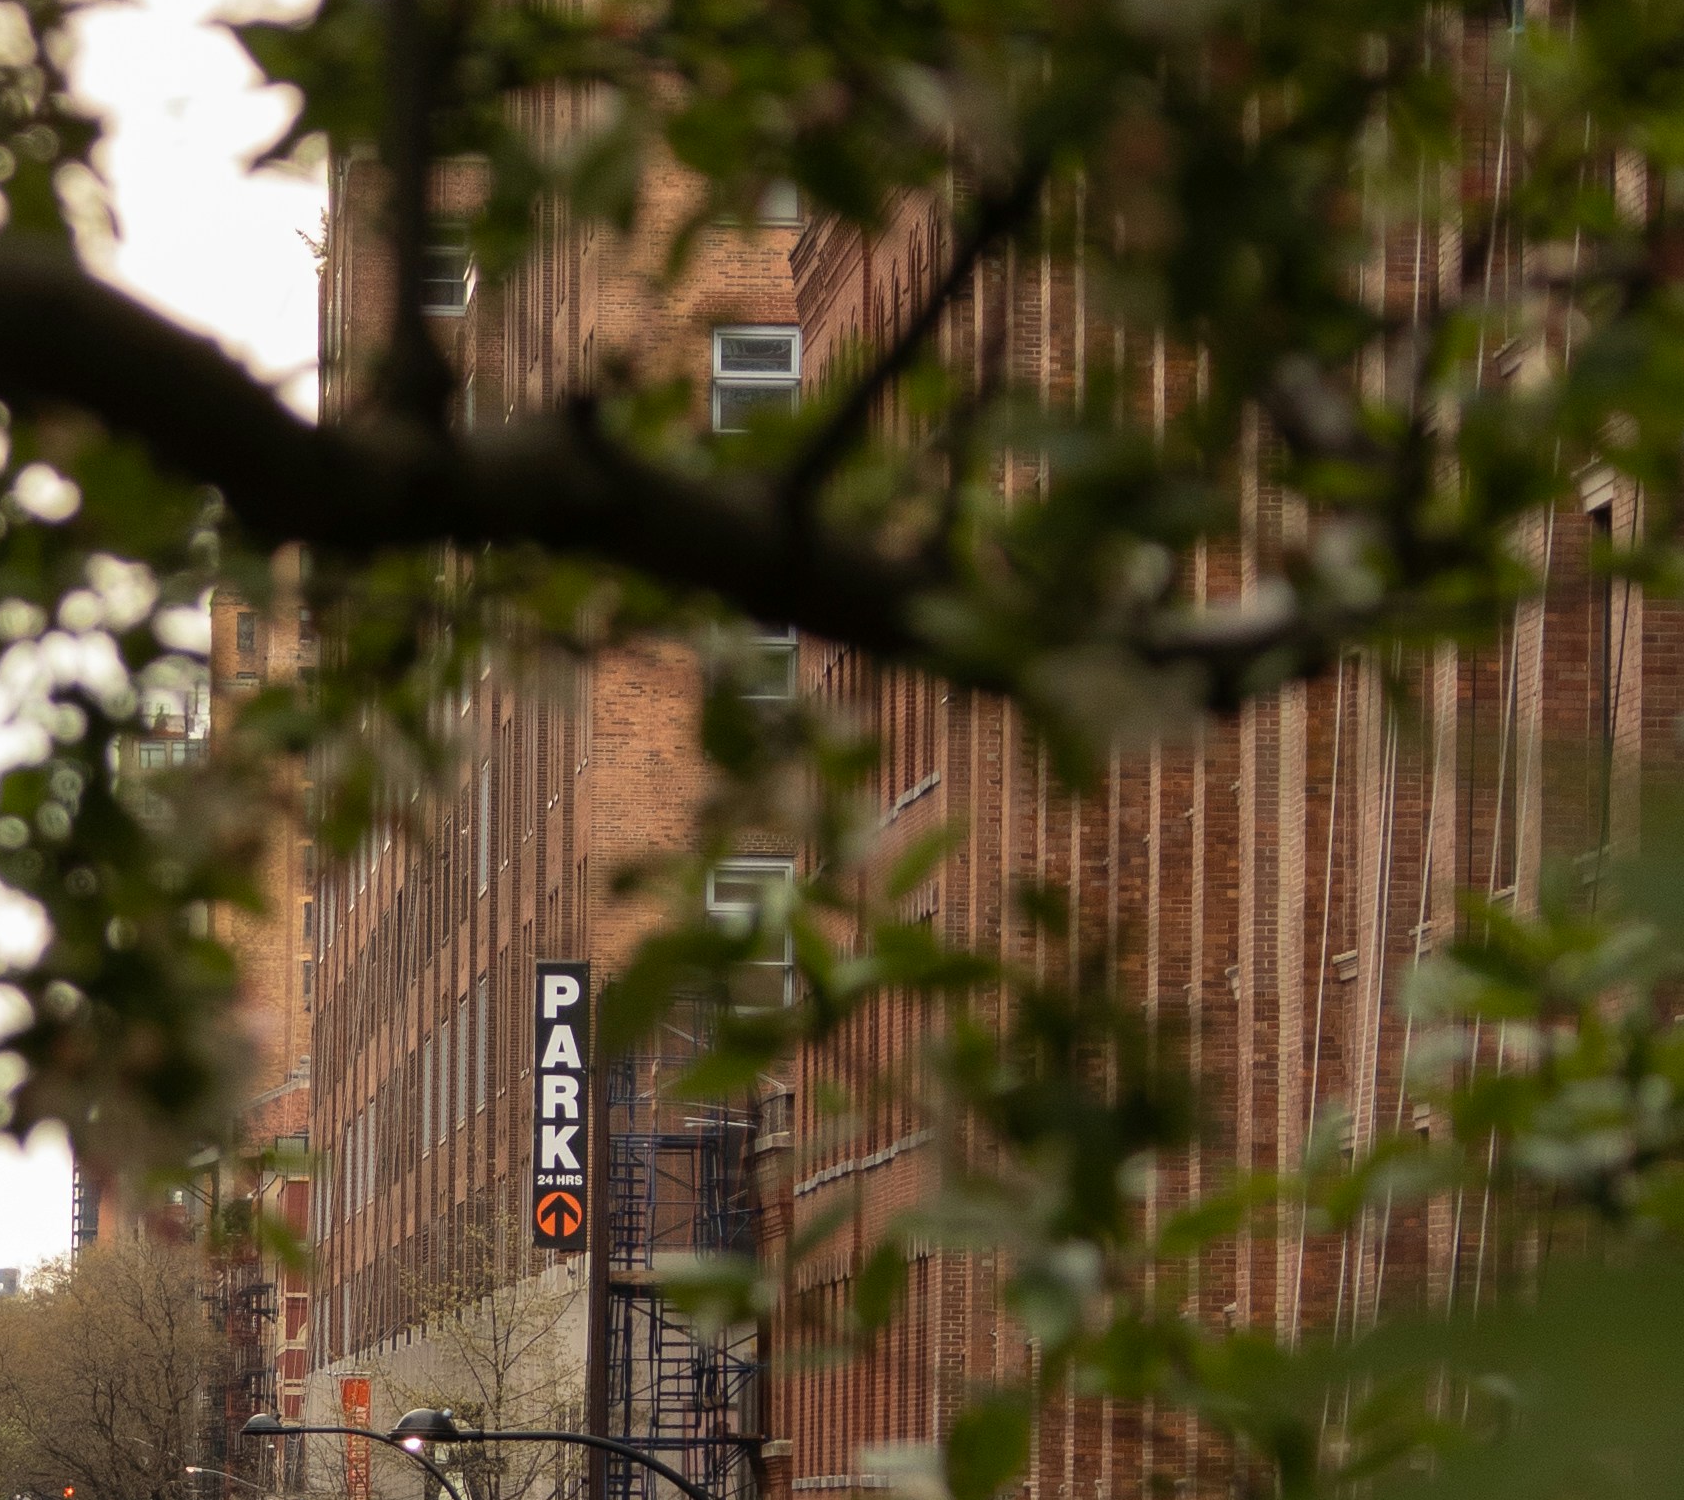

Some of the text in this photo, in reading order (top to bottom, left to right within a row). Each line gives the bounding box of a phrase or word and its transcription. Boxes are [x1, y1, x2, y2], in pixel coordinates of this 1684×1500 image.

[541, 974, 582, 1169] PARK
[537, 1174, 583, 1186] 24 HRS
